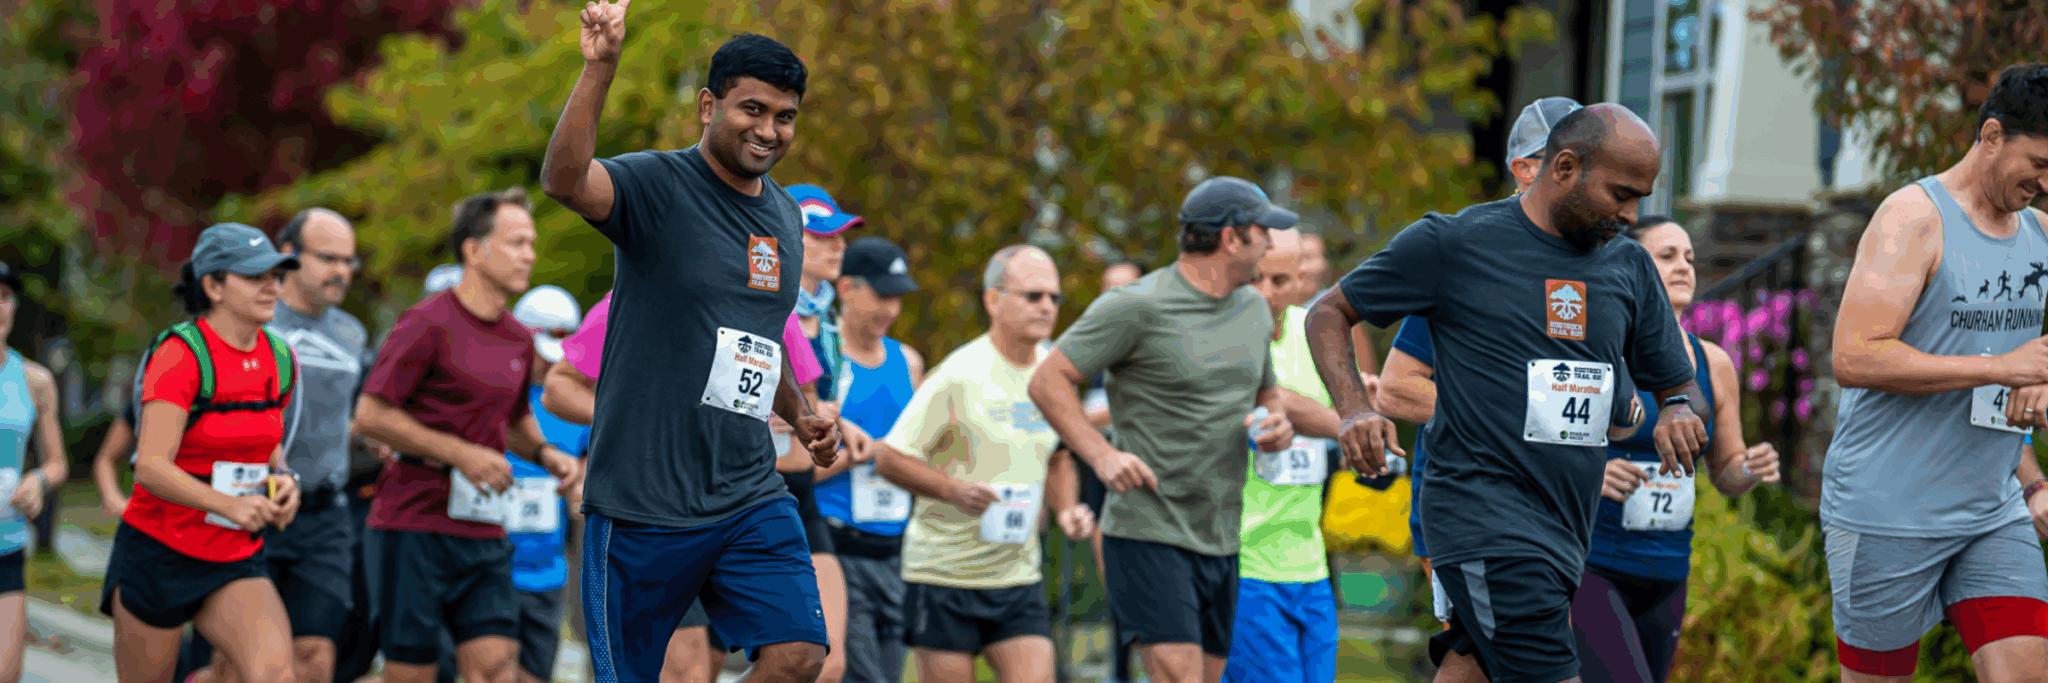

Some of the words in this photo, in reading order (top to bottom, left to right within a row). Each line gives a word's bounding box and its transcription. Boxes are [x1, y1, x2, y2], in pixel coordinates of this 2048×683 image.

[1951, 309, 2004, 332] CHURHAM
[735, 353, 748, 362] Half
[748, 356, 772, 371] Marathon
[738, 368, 763, 397] 52
[1552, 383, 1567, 392] Half
[1562, 397, 1590, 425] 44
[1993, 388, 2011, 411] 4
[1651, 491, 1673, 514] 72
